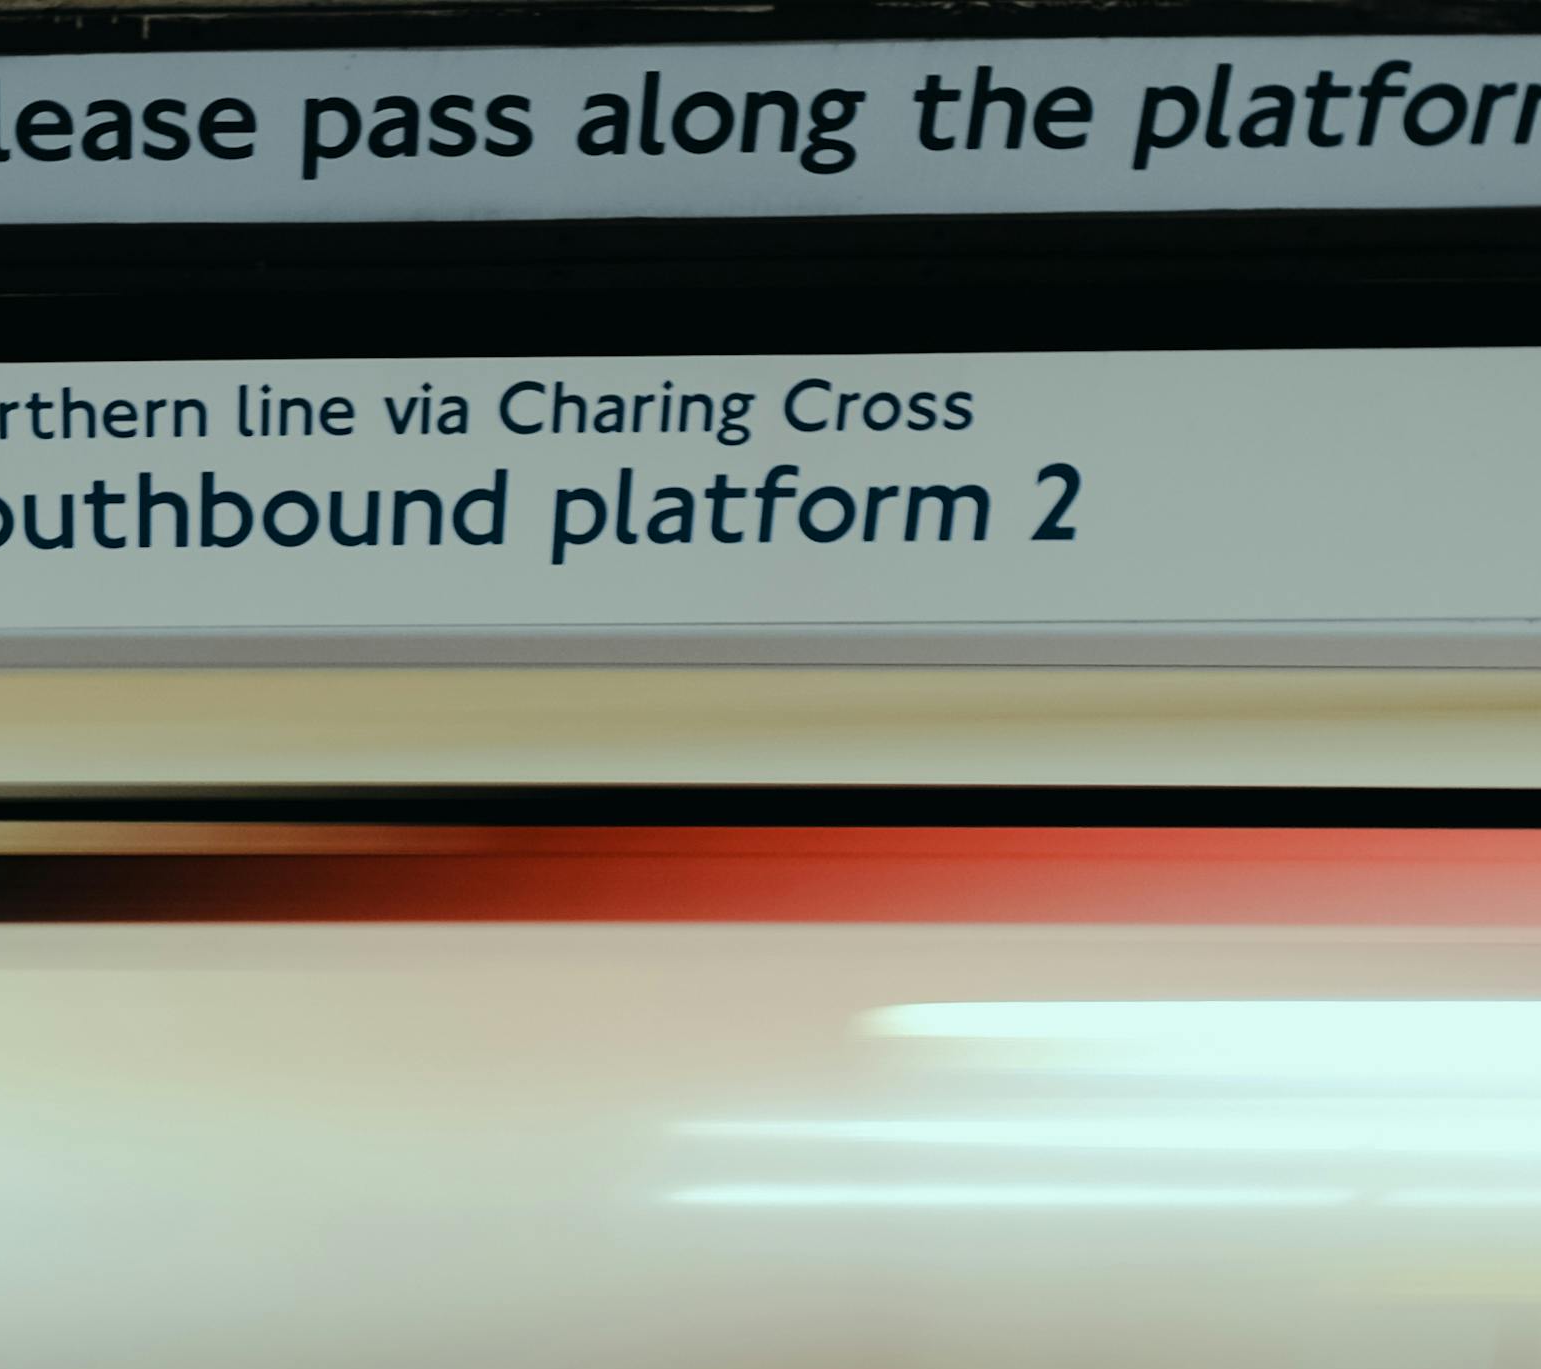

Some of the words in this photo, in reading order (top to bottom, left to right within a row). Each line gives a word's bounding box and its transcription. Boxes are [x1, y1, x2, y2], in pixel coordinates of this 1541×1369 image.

[301, 92, 534, 181] pass
[575, 69, 866, 175] along
[914, 64, 1094, 151] the
[237, 382, 356, 438] line
[382, 381, 469, 436] via
[497, 379, 757, 447] Charing
[782, 376, 974, 433] Cross
[550, 462, 991, 566] platform
[1029, 461, 1082, 541] 2
